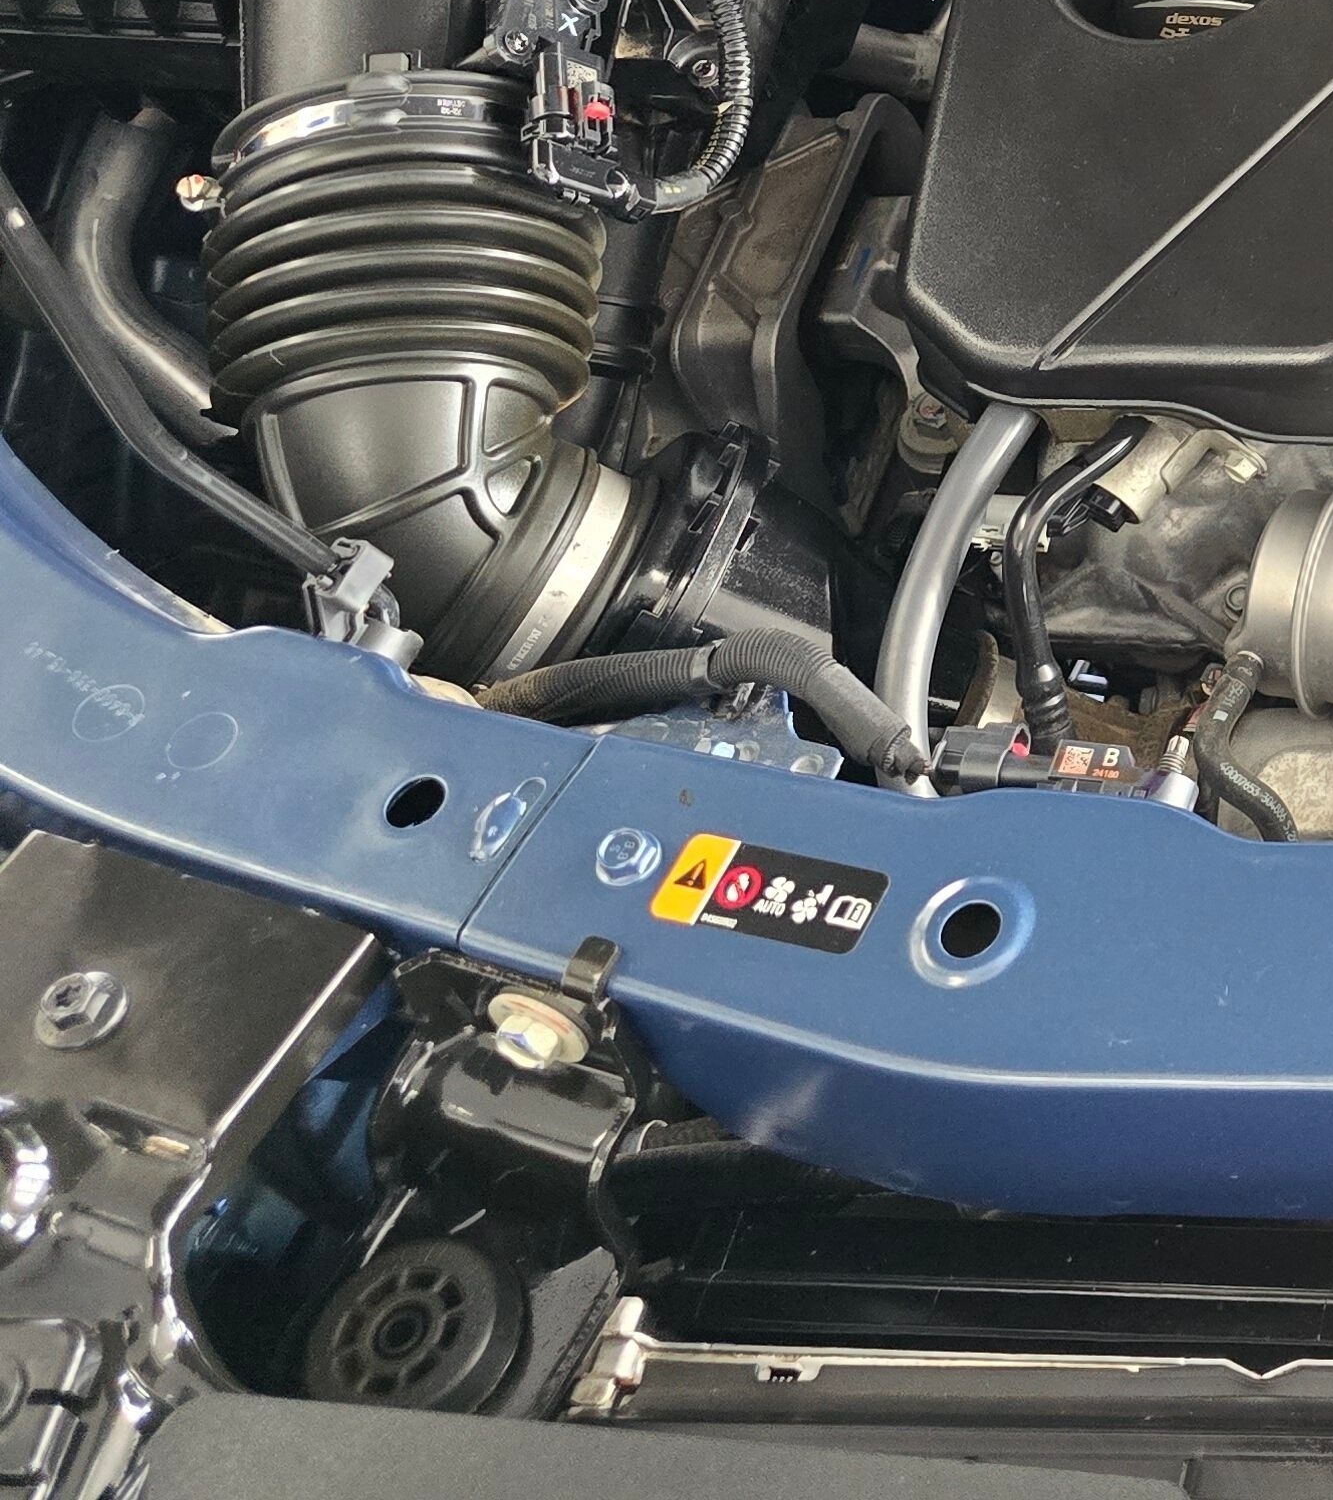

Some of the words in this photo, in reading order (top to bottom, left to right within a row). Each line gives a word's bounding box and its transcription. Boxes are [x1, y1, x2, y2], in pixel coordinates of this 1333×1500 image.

[1165, 12, 1224, 27] dexos
[1102, 747, 1121, 767] B
[1092, 768, 1120, 779] 24180
[752, 899, 787, 918] AUTO
